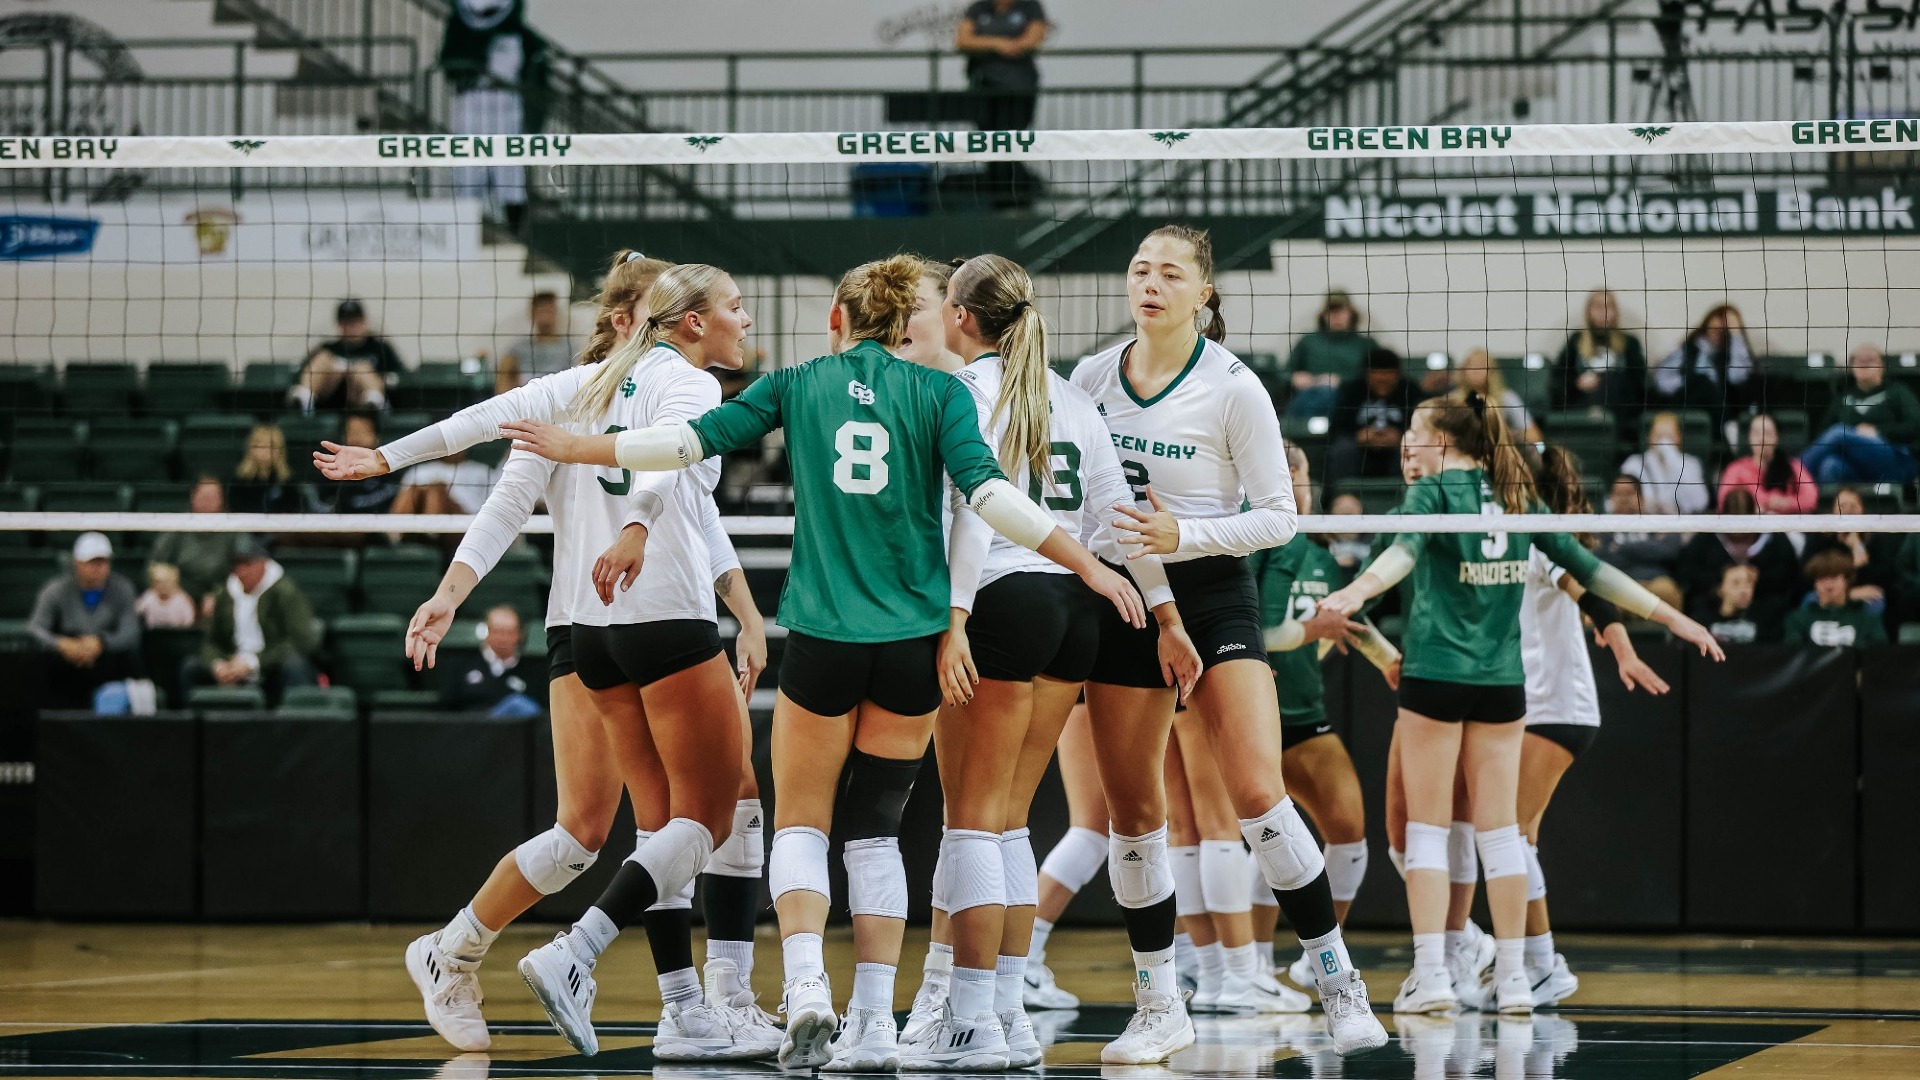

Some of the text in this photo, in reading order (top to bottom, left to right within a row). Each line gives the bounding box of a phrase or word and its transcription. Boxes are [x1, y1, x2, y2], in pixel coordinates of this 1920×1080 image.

[1697, 0, 1920, 33] FASS
[837, 131, 1036, 154] GREEN BAY
[1308, 126, 1512, 150] GREEN BAY
[1792, 121, 1917, 144] GREEN
[0, 139, 118, 159] EN BAY
[378, 135, 572, 158] GREEN BAY
[1325, 187, 1914, 238] Nicolet National Bank
[833, 421, 890, 495] 8
[1111, 433, 1197, 460] EEN BAY
